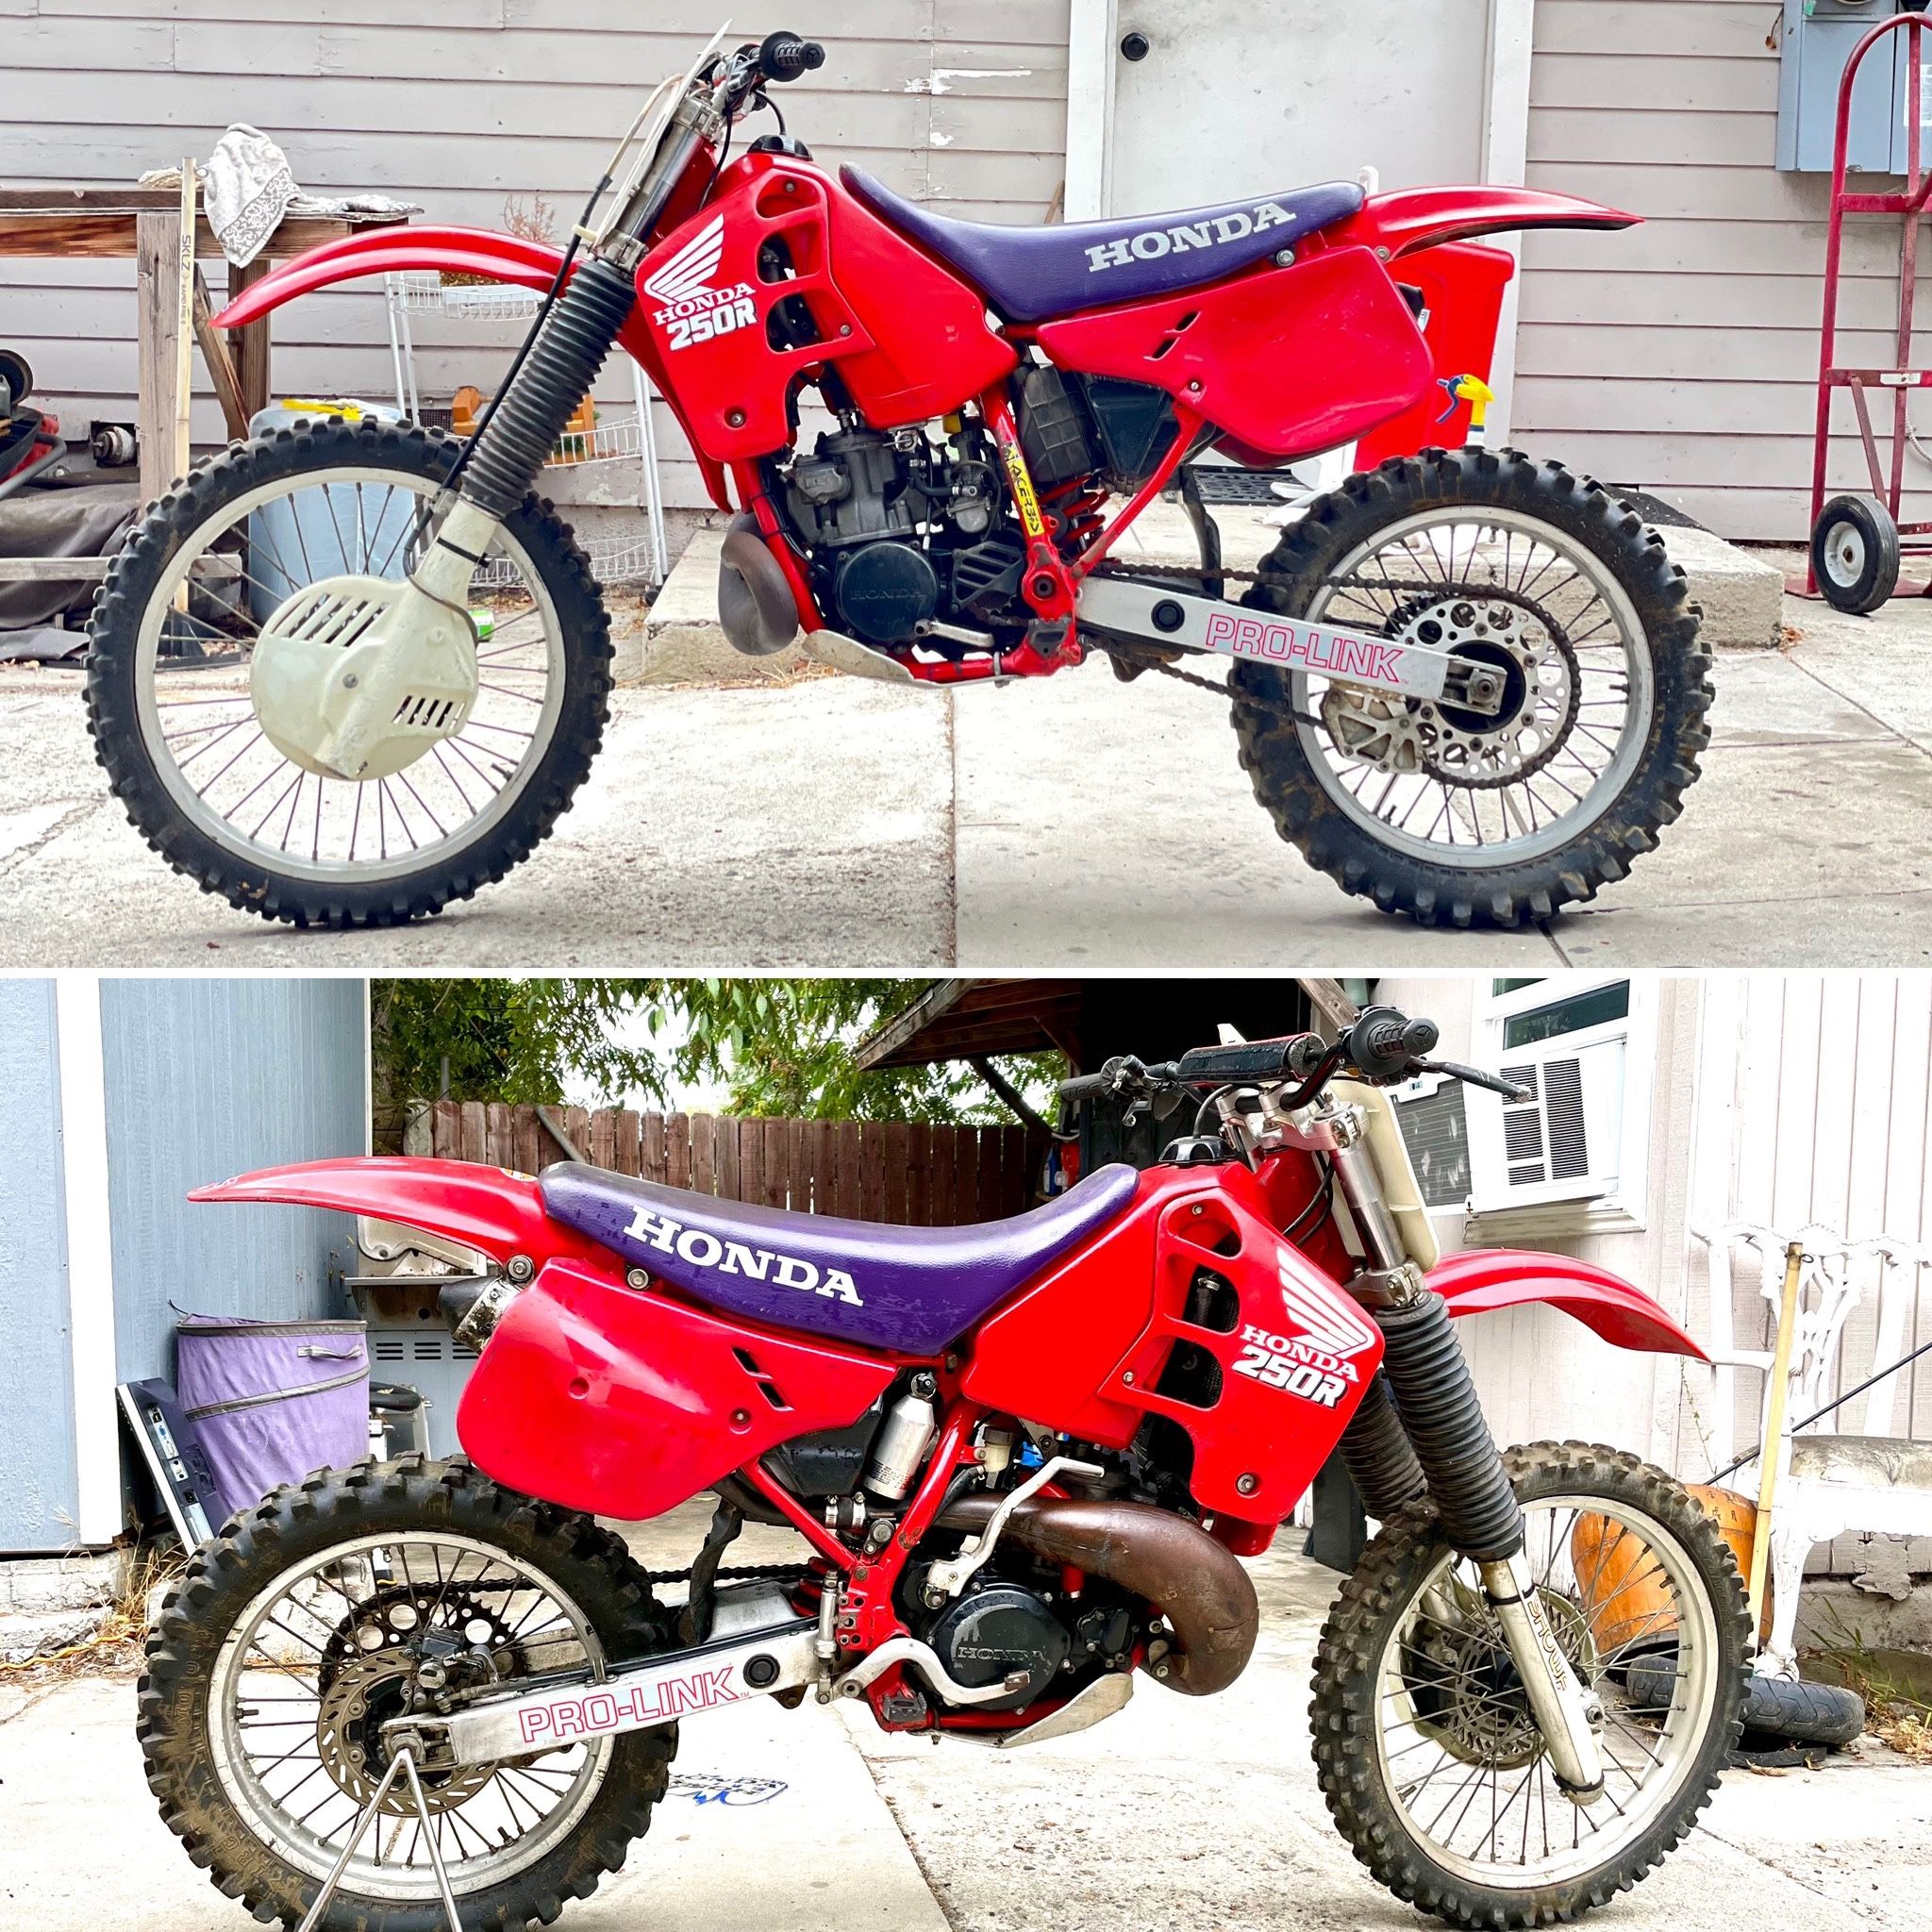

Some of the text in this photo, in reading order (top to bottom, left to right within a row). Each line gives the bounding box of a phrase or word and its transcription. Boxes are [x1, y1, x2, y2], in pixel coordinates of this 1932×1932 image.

[180, 234, 192, 271] SKLZ
[1085, 202, 1297, 273] HONDA
[652, 282, 757, 326] HONDA
[666, 297, 758, 352] 250R
[1206, 613, 1400, 684] PRO-LINK
[623, 1205, 864, 1307] HONDA
[1231, 1343, 1349, 1410] 250R
[1239, 1323, 1360, 1384] HONDA
[519, 1666, 740, 1743] PRO-LINK
